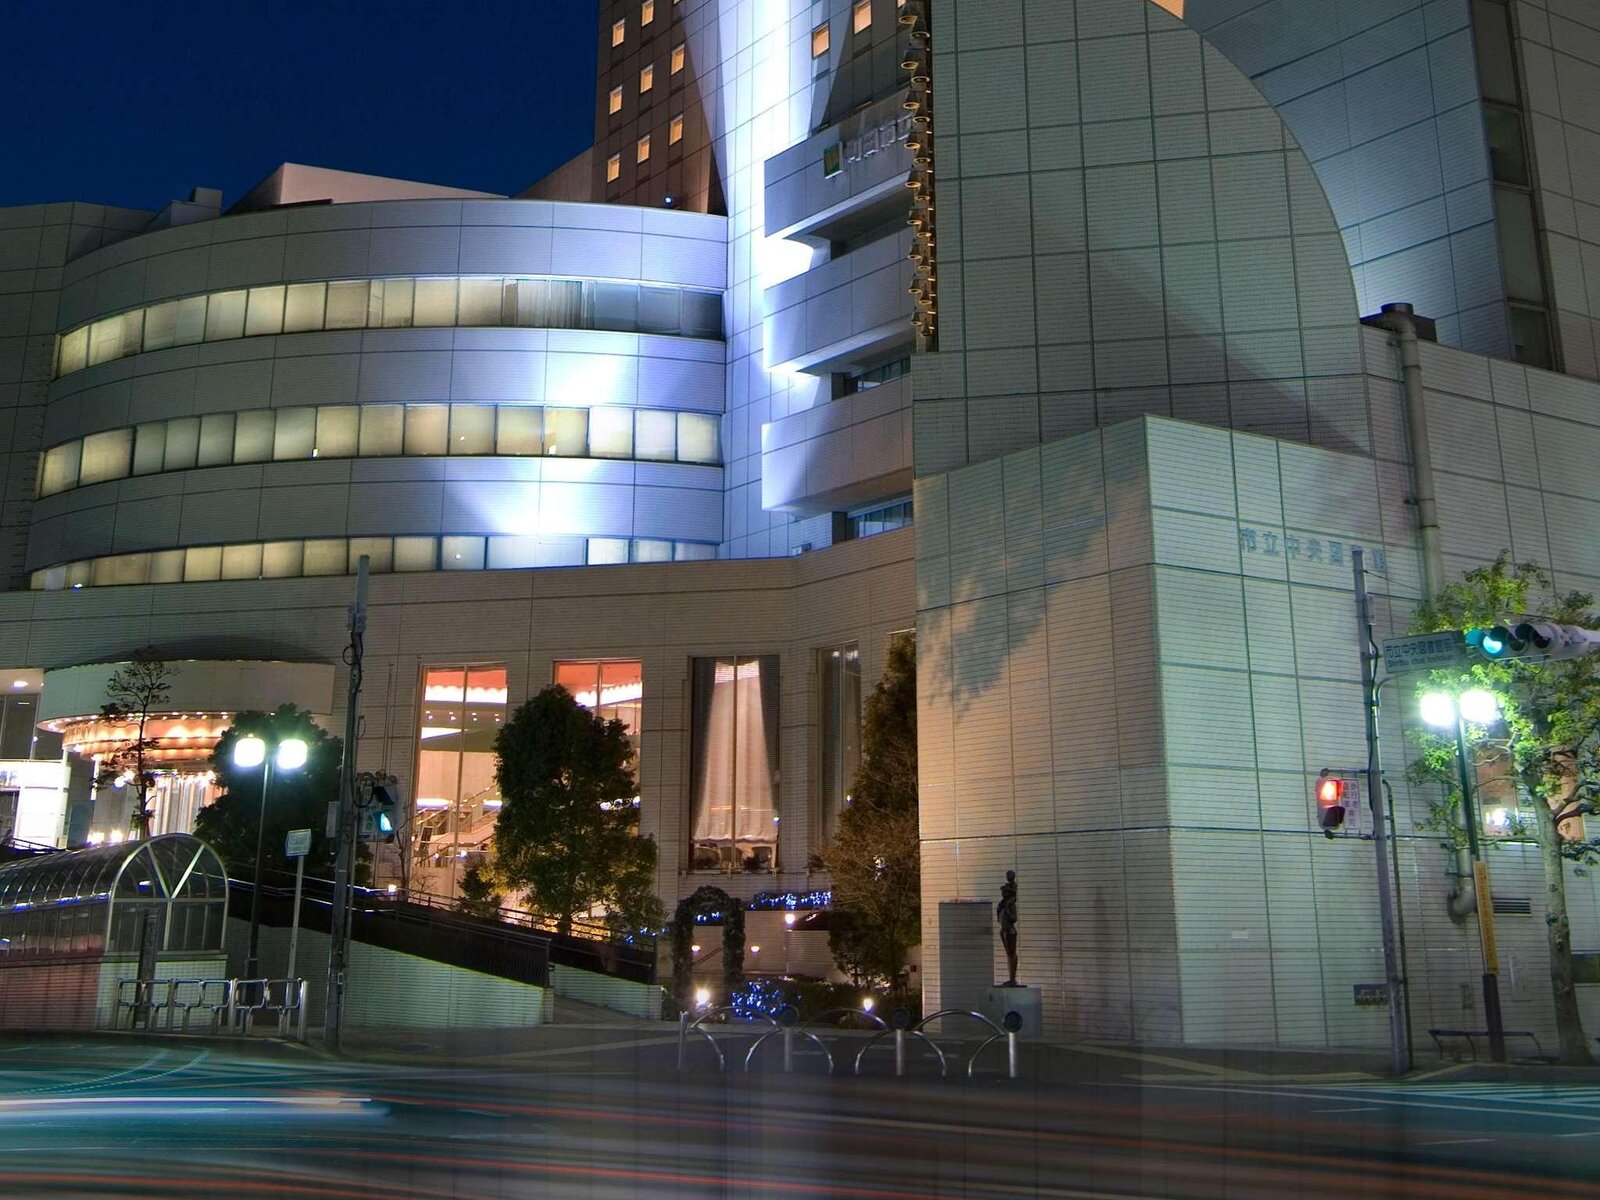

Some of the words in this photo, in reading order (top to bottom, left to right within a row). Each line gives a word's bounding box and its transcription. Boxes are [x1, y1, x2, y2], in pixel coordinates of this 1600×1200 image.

[1241, 527, 1386, 571] 市立中央図館
